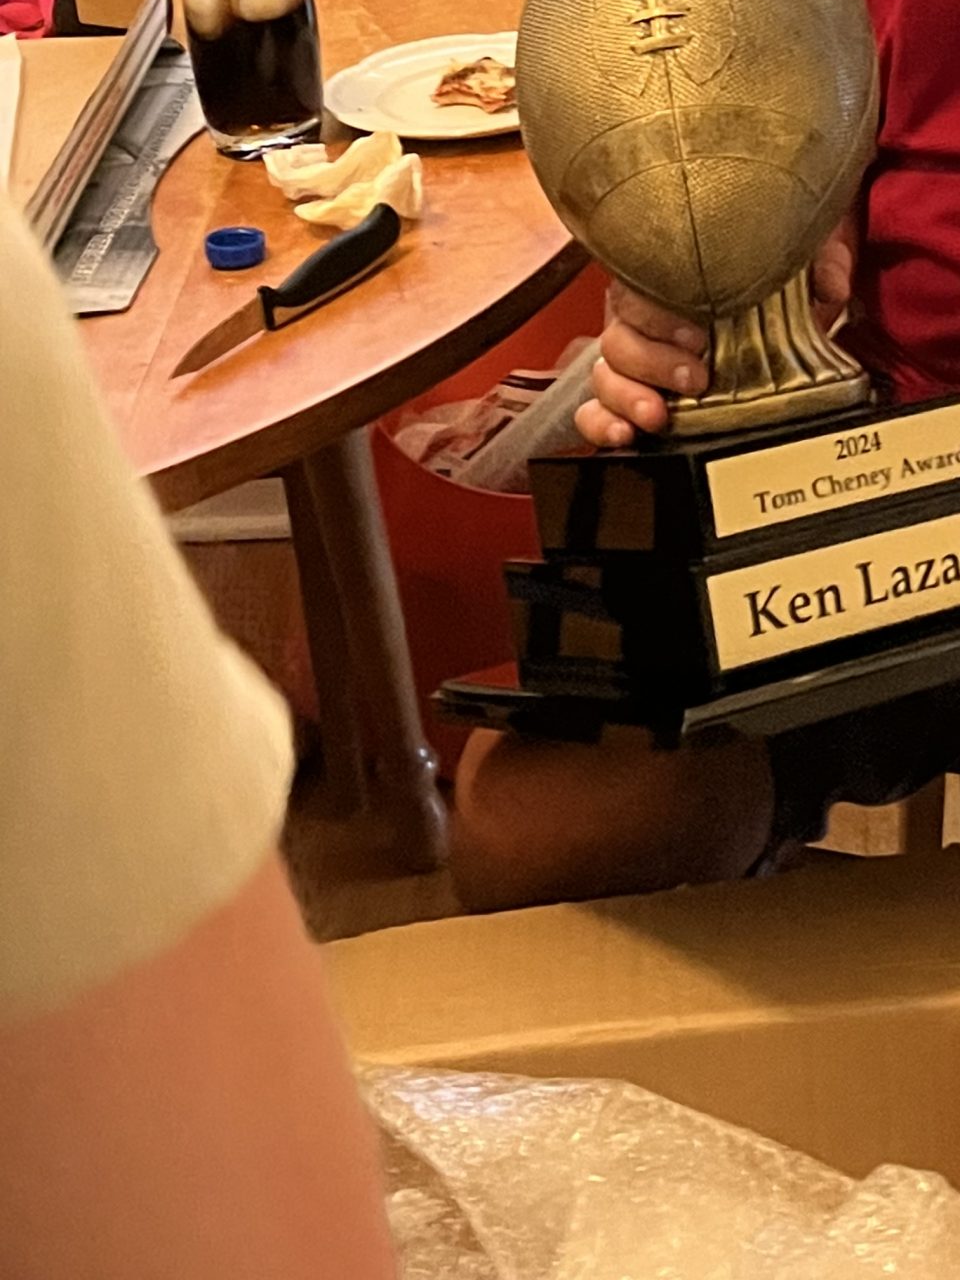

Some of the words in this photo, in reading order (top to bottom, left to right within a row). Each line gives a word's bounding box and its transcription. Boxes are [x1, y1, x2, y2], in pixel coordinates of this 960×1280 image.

[834, 431, 882, 461] 2024
[753, 488, 807, 514] Tom
[811, 466, 893, 500] Cheney
[743, 584, 845, 638] Ken
